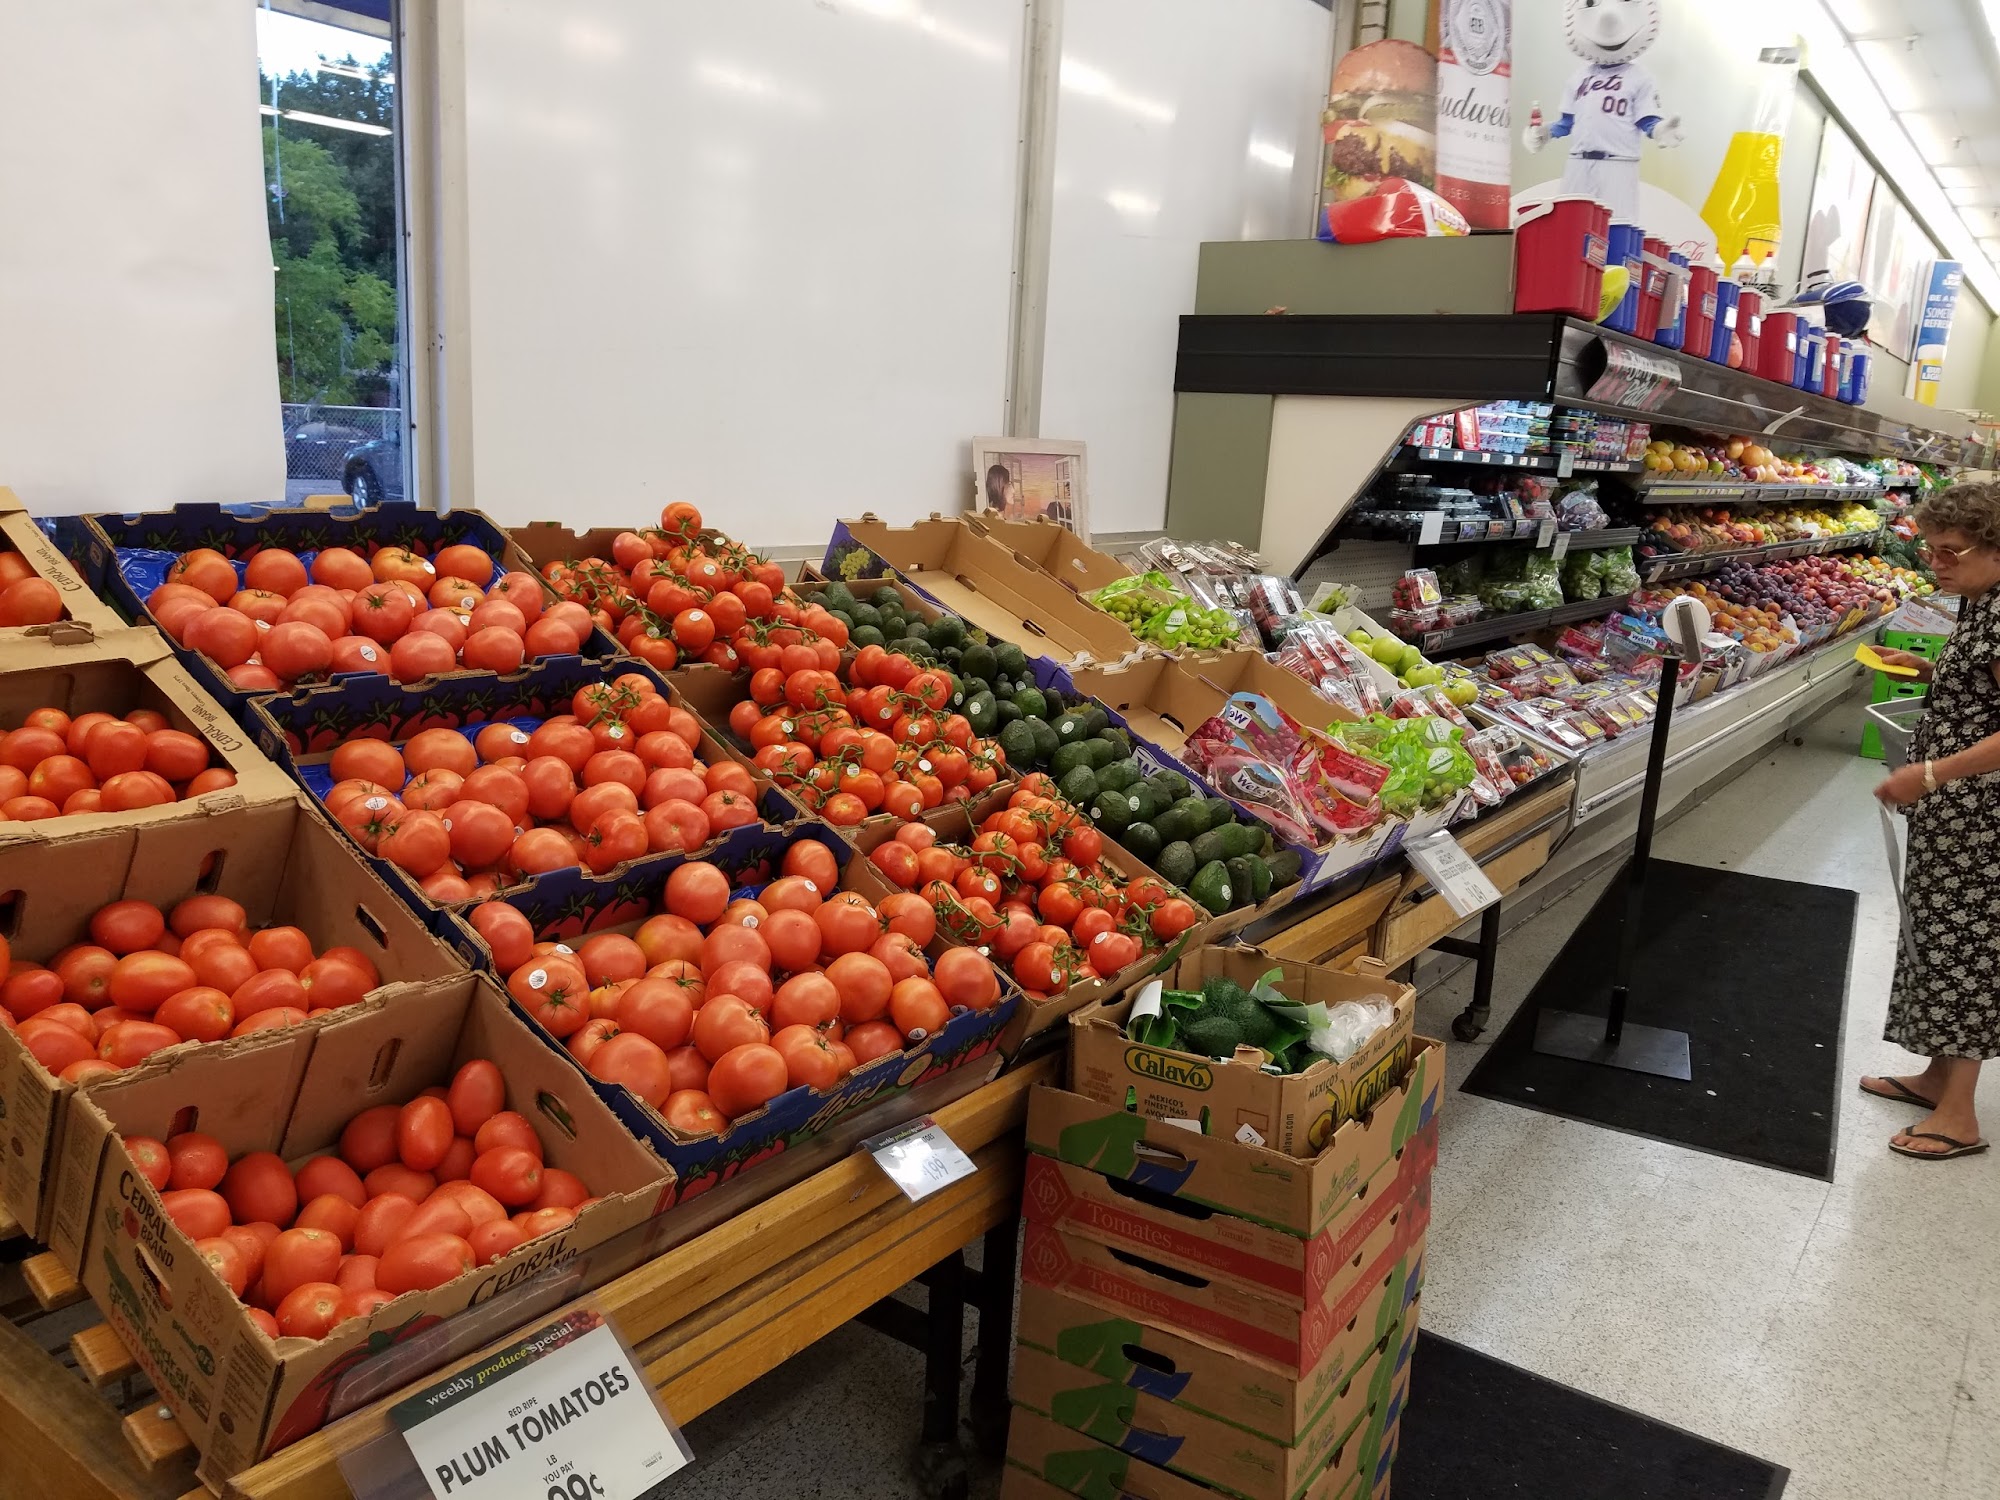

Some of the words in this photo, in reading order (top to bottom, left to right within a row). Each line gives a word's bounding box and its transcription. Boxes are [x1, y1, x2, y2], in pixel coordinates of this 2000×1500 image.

[1438, 86, 1511, 129] udwei
[1602, 95, 1628, 117] 00
[45, 566, 82, 592] CEDRAL
[191, 704, 218, 724] BRAND
[202, 723, 243, 752] CEDRAL
[1134, 1051, 1207, 1089] Calavo
[1169, 1106, 1188, 1117] HASS
[119, 1170, 167, 1244] CEDRAL
[1087, 1202, 1173, 1250] Tomates
[140, 1224, 174, 1268] BRAND
[467, 1236, 567, 1308] CEDRAL
[1087, 1268, 1171, 1316] Tomates
[426, 1374, 475, 1406] weekly
[476, 1349, 528, 1384] produce
[528, 1323, 574, 1352] special
[508, 1405, 523, 1418] RED
[522, 1397, 538, 1410] RIPE
[435, 1435, 510, 1494] PLUM
[506, 1366, 629, 1451] TOMATOES
[543, 1471, 560, 1484] YOU
[559, 1461, 575, 1474] PAY
[546, 1454, 557, 1466] LB
